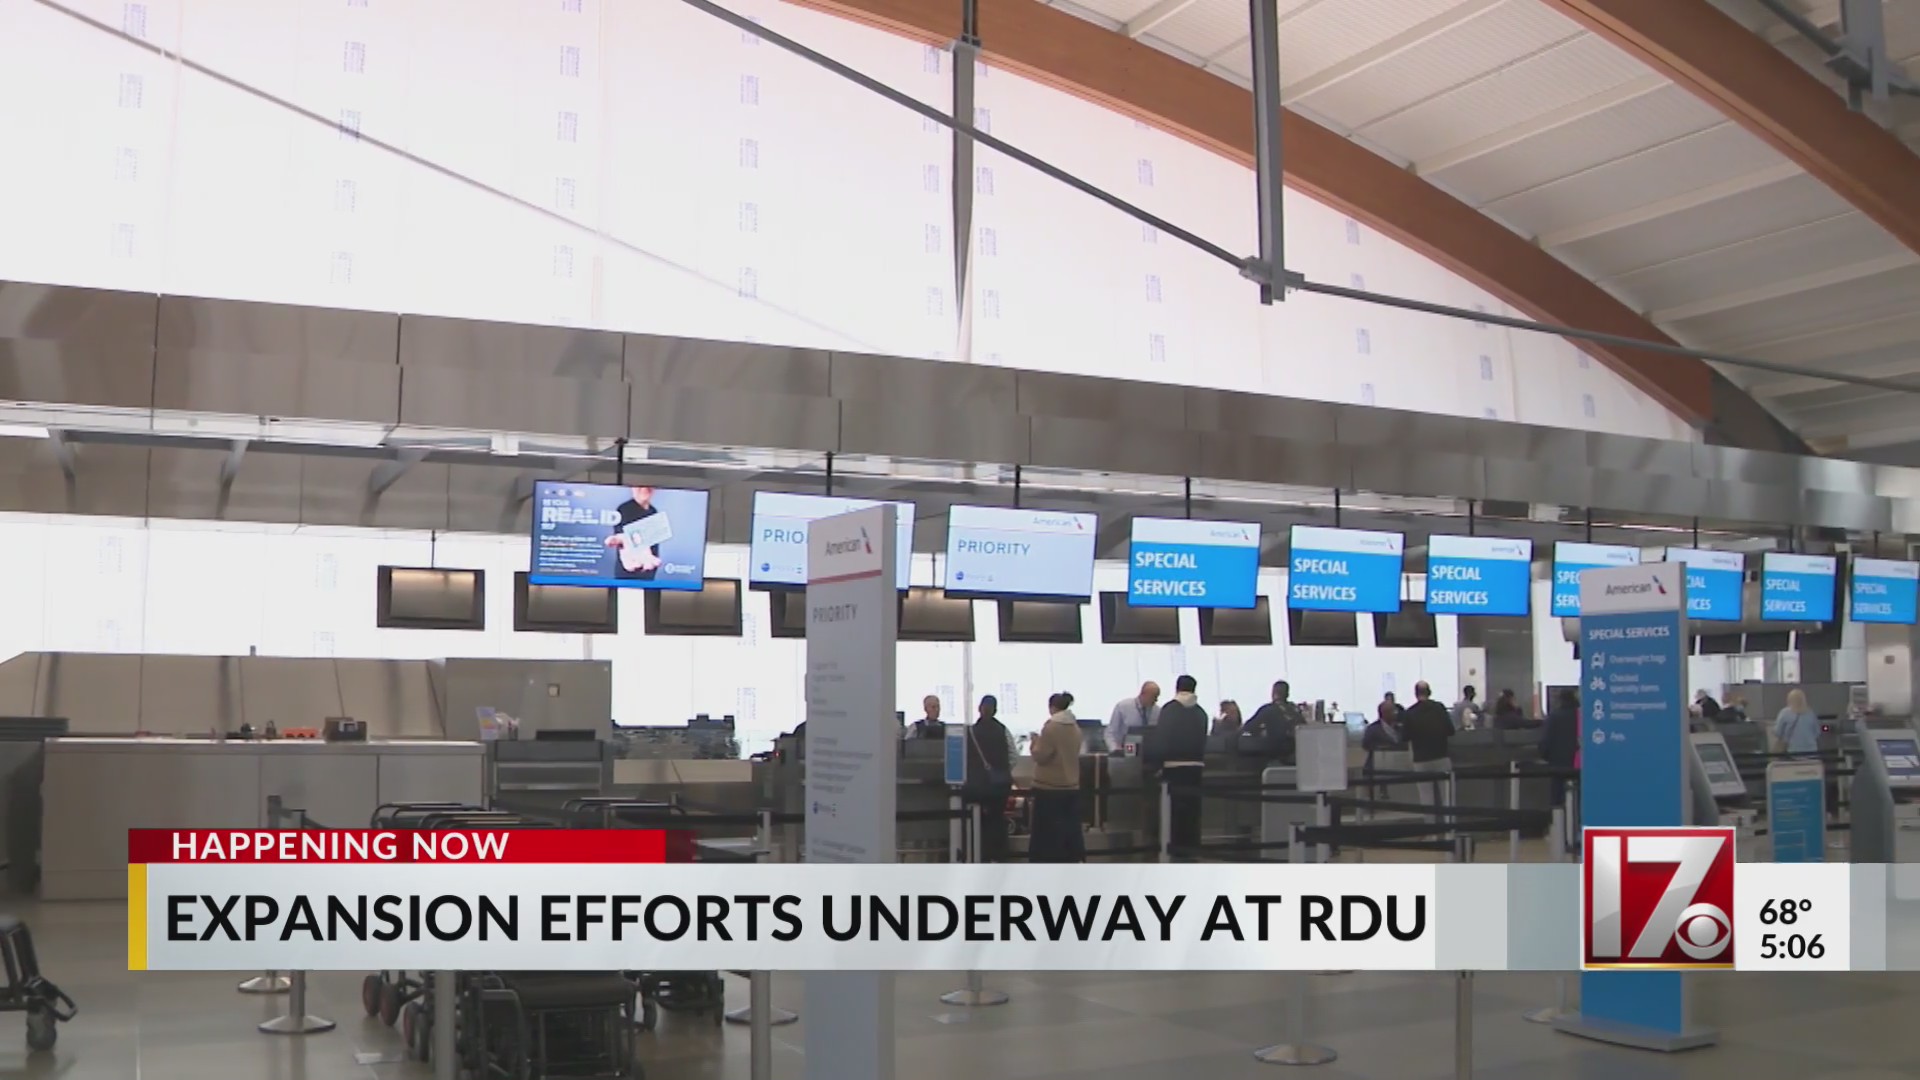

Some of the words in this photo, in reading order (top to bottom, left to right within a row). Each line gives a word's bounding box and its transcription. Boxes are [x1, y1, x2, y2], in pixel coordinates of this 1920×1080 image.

[542, 507, 599, 524] REAL
[600, 509, 623, 526] ID
[763, 528, 807, 544] PRIO
[825, 538, 861, 556] American
[957, 539, 1031, 556] PRIORITY
[1135, 551, 1198, 569] SPECIAL
[1294, 558, 1349, 575] SPECIAL
[1431, 565, 1482, 581] SPECIAL
[1557, 570, 1581, 585] SPEC
[1133, 579, 1207, 597] SERVICES
[1293, 584, 1357, 601] SERVICES
[1605, 582, 1652, 596] American
[1765, 578, 1801, 592] SPECIAL
[1855, 583, 1888, 595] SPECIAL
[1430, 590, 1489, 606] SERVICES
[1764, 599, 1807, 613] SERVICES
[812, 603, 858, 623] PRIORITY
[1854, 602, 1892, 615] SERVICES
[1588, 628, 1626, 640] SPECIAL
[1626, 625, 1670, 638] SERVICES
